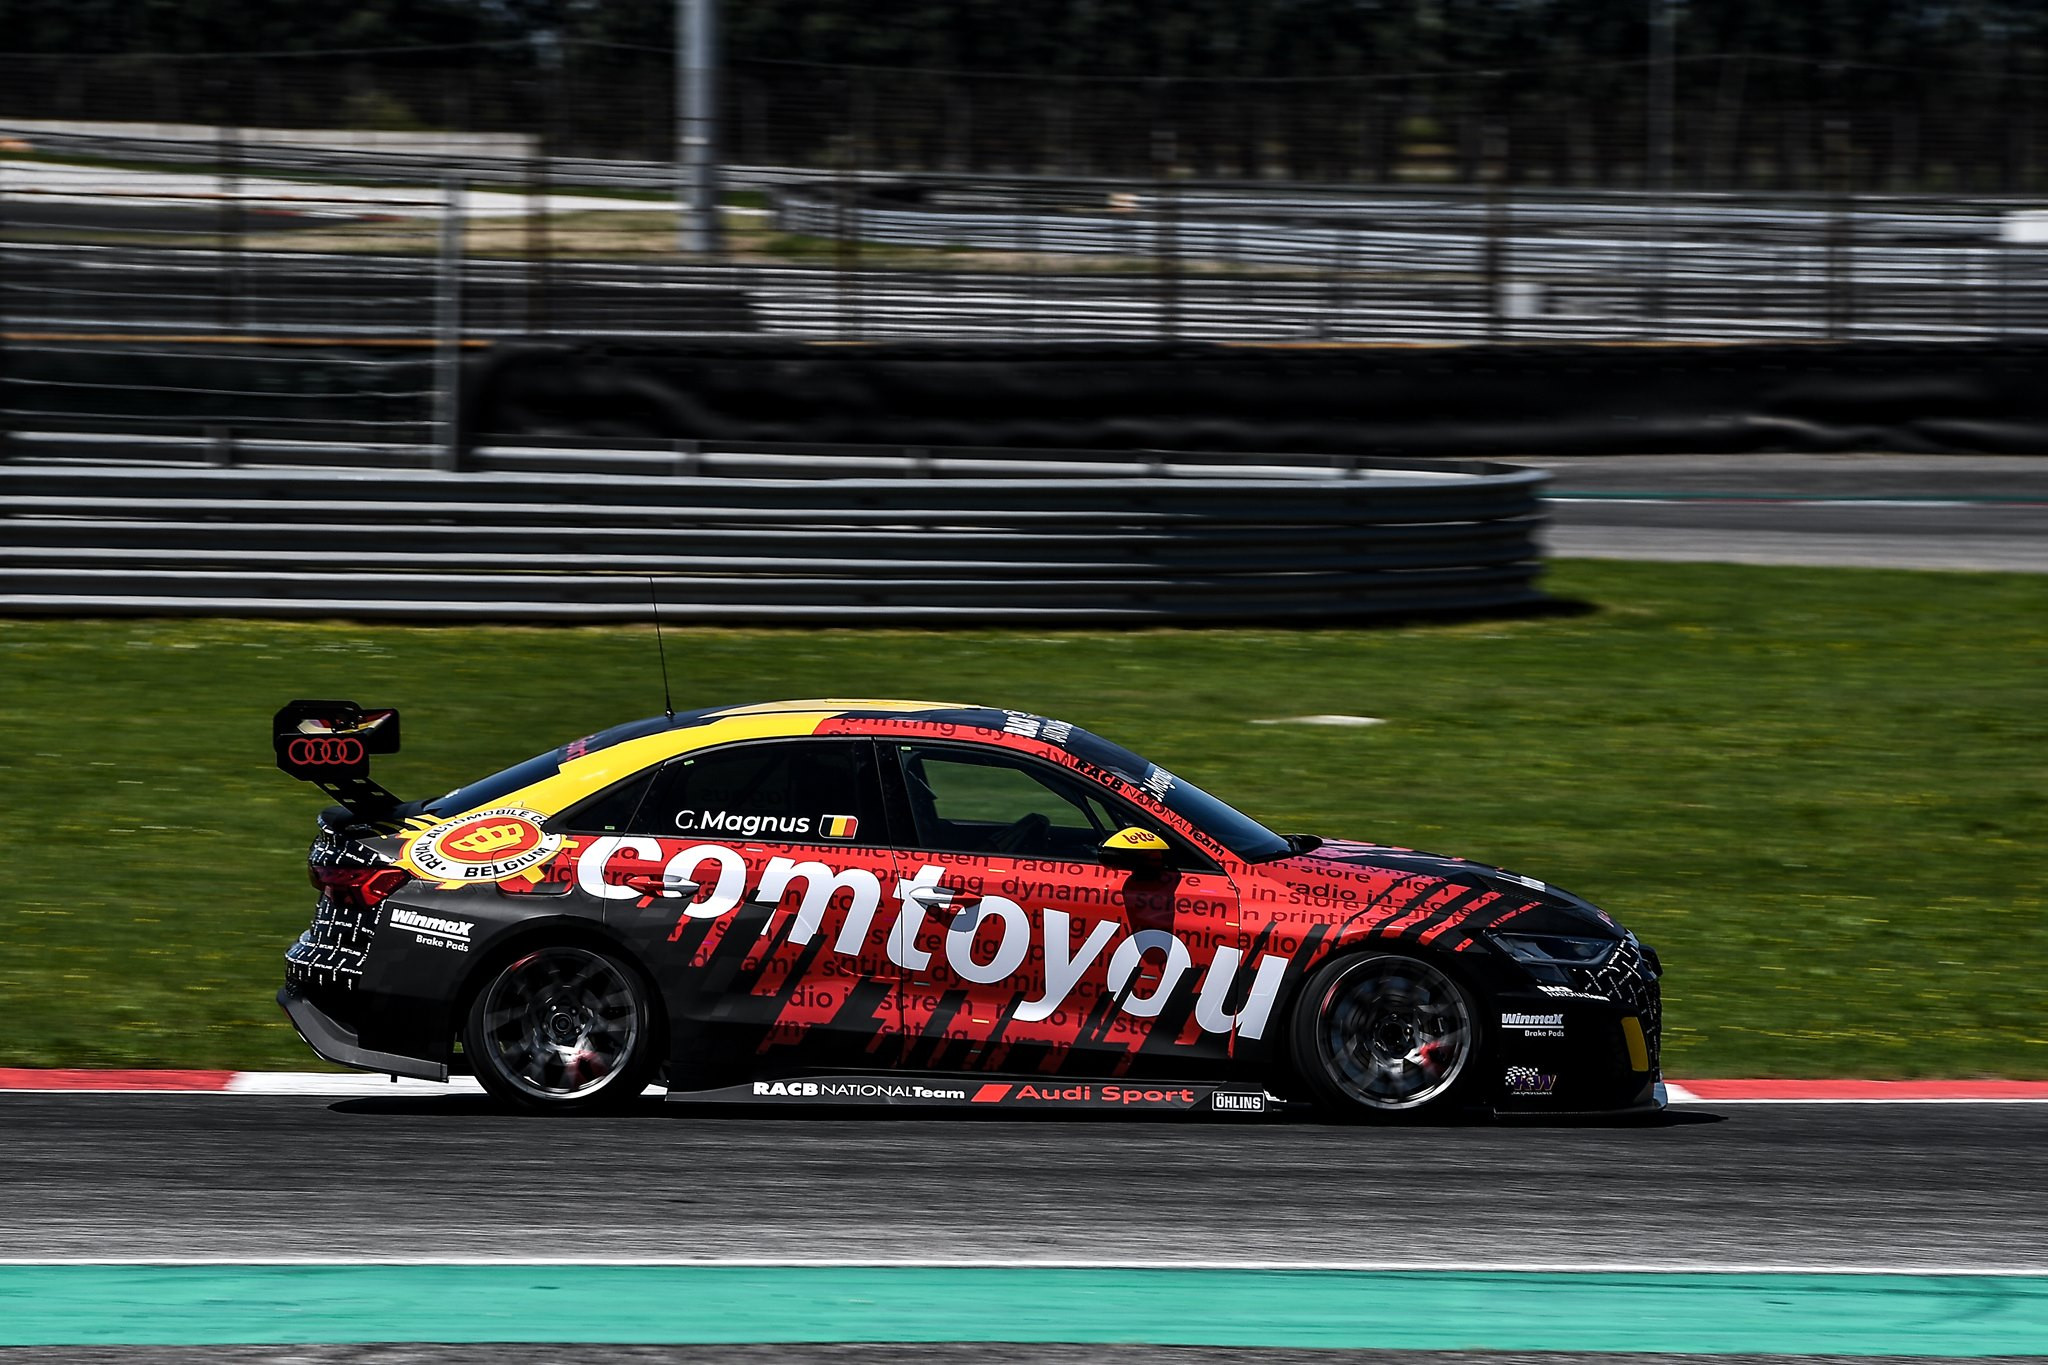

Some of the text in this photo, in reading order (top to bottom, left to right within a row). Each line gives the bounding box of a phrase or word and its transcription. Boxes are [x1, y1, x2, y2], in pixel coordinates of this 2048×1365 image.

[1073, 760, 1122, 791] RACB
[675, 809, 811, 836] G.Magnus
[415, 840, 442, 870] ROYAL
[430, 808, 530, 840] AUTOMOBILE
[463, 846, 550, 878] BELGIUM
[1001, 875, 1125, 907] dynamic
[1251, 884, 1360, 912] in-store
[1285, 880, 1357, 902] radio
[415, 934, 470, 953] Brake Pads
[577, 835, 1289, 1041] comtoyou
[1524, 1029, 1565, 1037] Brake Pads
[752, 1081, 818, 1096] RACB
[1015, 1084, 1090, 1101] Audi
[1101, 1086, 1195, 1105] Sport
[1215, 1092, 1262, 1110] ÖHLINS
